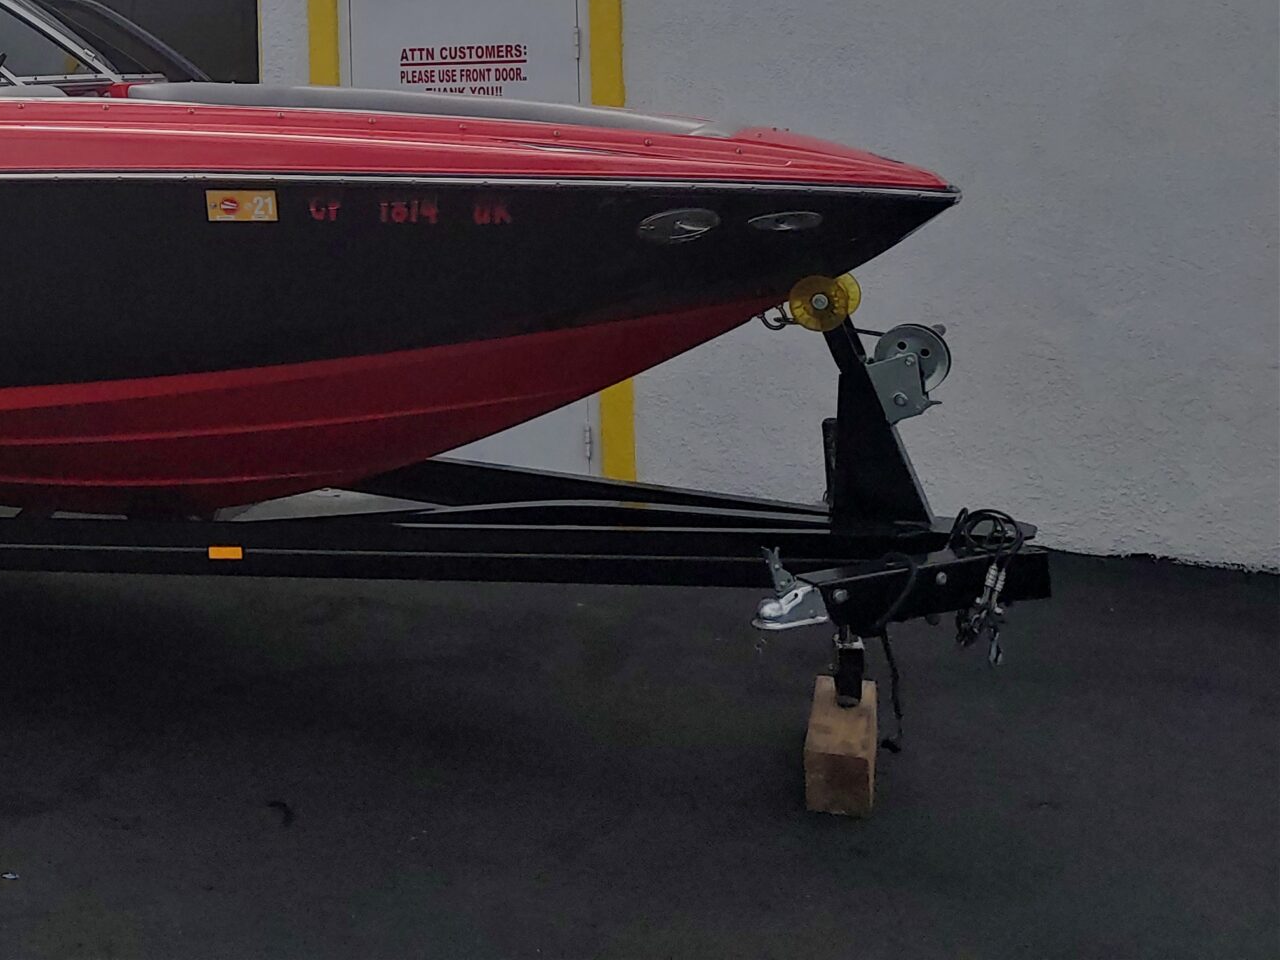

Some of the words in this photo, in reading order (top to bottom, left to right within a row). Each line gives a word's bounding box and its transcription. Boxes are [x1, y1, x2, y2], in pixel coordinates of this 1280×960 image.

[400, 47, 435, 62] ATTN
[440, 44, 527, 60] CUSTOMERS:
[400, 69, 436, 84] PLEASE
[438, 69, 457, 83] USE
[460, 68, 492, 83] FRONT
